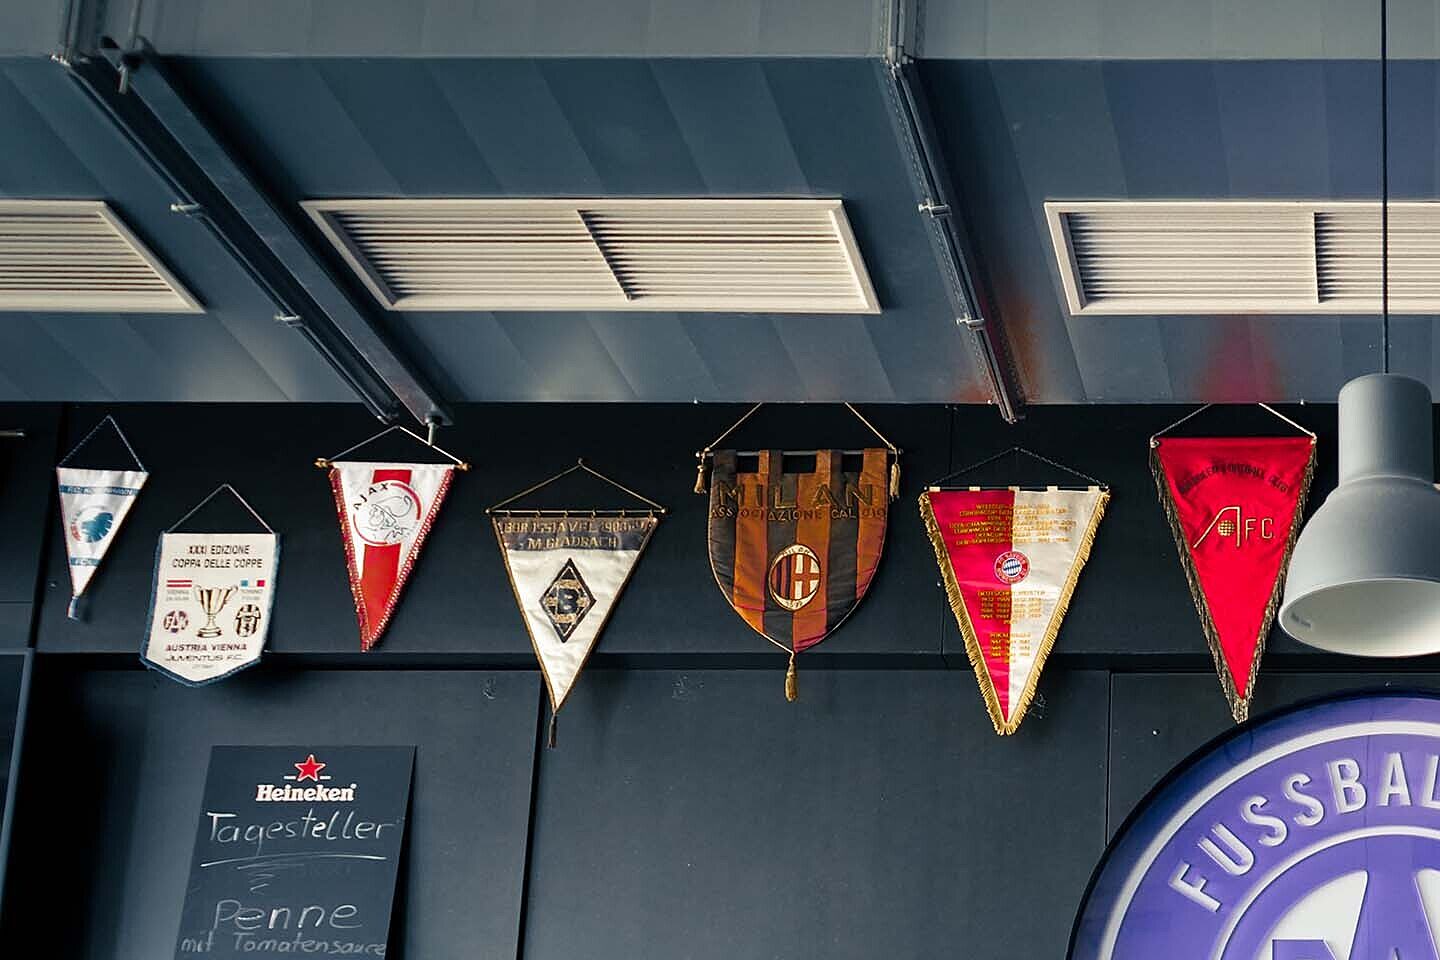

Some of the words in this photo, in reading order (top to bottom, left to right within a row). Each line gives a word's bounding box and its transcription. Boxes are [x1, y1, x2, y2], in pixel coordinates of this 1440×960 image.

[352, 482, 389, 511] AJAX
[718, 481, 874, 510] MILAN
[210, 545, 251, 555] EDIZIONE
[171, 558, 202, 569] COPPA
[204, 558, 231, 569] DELLE
[233, 558, 263, 569] COPPE
[165, 643, 208, 652] AUSTRIA
[211, 643, 248, 652] VIENNA
[255, 783, 358, 803] Heineken
[206, 808, 398, 858] Tagesteller
[213, 899, 364, 931] Penne
[181, 931, 214, 953] mit
